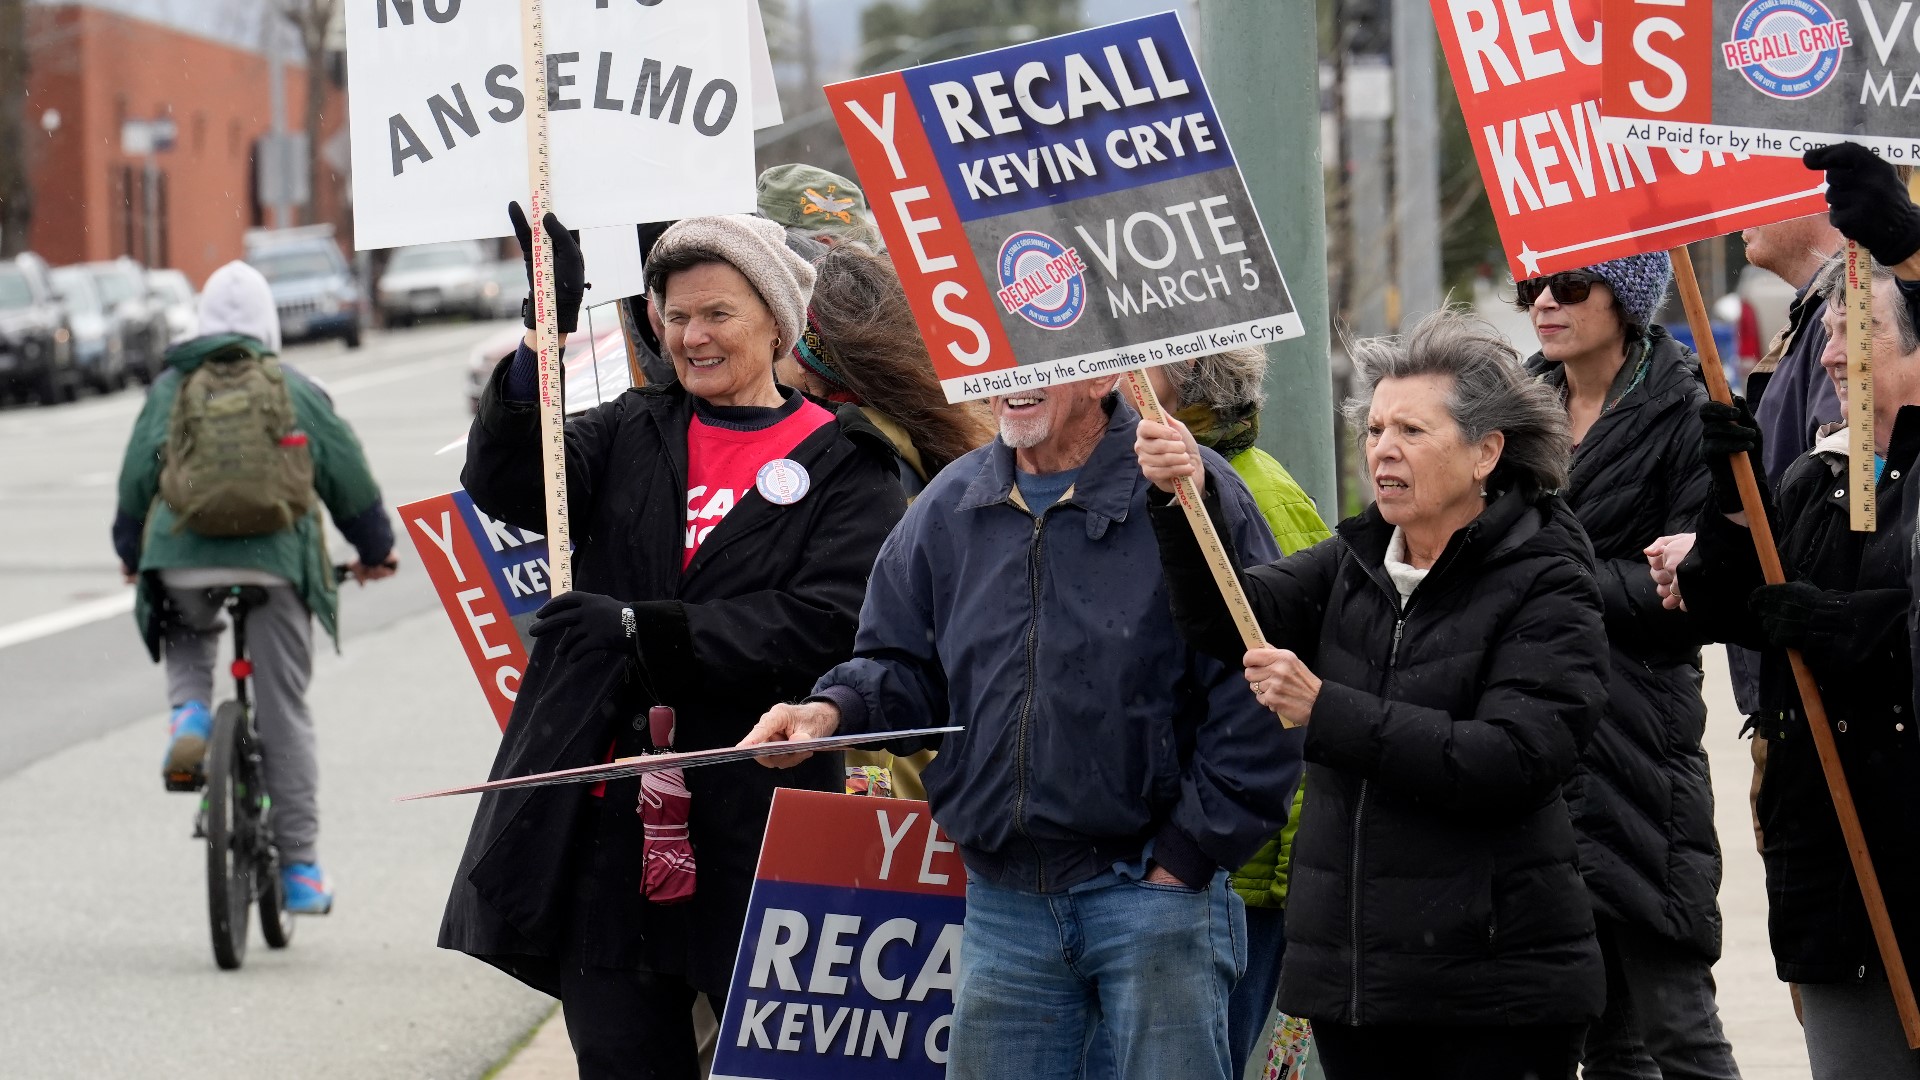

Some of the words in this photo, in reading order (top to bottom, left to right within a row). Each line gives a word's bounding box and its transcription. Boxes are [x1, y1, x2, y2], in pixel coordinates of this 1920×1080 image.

[1628, 0, 1688, 112] S
[1724, 33, 1797, 68] RECALL
[1799, 22, 1850, 52] CRYE
[389, 51, 738, 177] ANSELMO
[929, 37, 1189, 144] RECALL
[958, 138, 1096, 200] KEVIN
[1105, 112, 1216, 170] CRYE
[1627, 124, 1650, 140] Ad
[1658, 126, 1692, 144] Paid
[1700, 128, 1723, 145] for
[1730, 130, 1750, 152] by
[1757, 133, 1782, 150] the
[1888, 145, 1903, 158] to
[534, 246, 542, 268] Back
[844, 92, 991, 367] YES
[1075, 194, 1247, 281] VOTE
[537, 290, 546, 324] County
[999, 270, 1052, 312] RECALL
[1046, 248, 1084, 284] CRYE
[1106, 265, 1230, 319] MARCH
[1240, 258, 1260, 291] 5
[964, 378, 981, 395] Ad
[984, 372, 1011, 391] Paid
[1013, 370, 1032, 385] for
[1034, 368, 1050, 384] by
[1055, 364, 1075, 378] the
[1078, 353, 1146, 374] Committee
[1149, 349, 1163, 360] to
[1166, 335, 1206, 356] Recall
[1209, 330, 1248, 348] Kevin
[1250, 325, 1283, 340] Crye
[1133, 384, 1145, 407] Crye
[774, 460, 786, 486] RECALL
[780, 486, 792, 503] CRYE
[876, 809, 956, 886] YE
[748, 907, 965, 1004] RECA
[736, 998, 909, 1060] KEVIN
